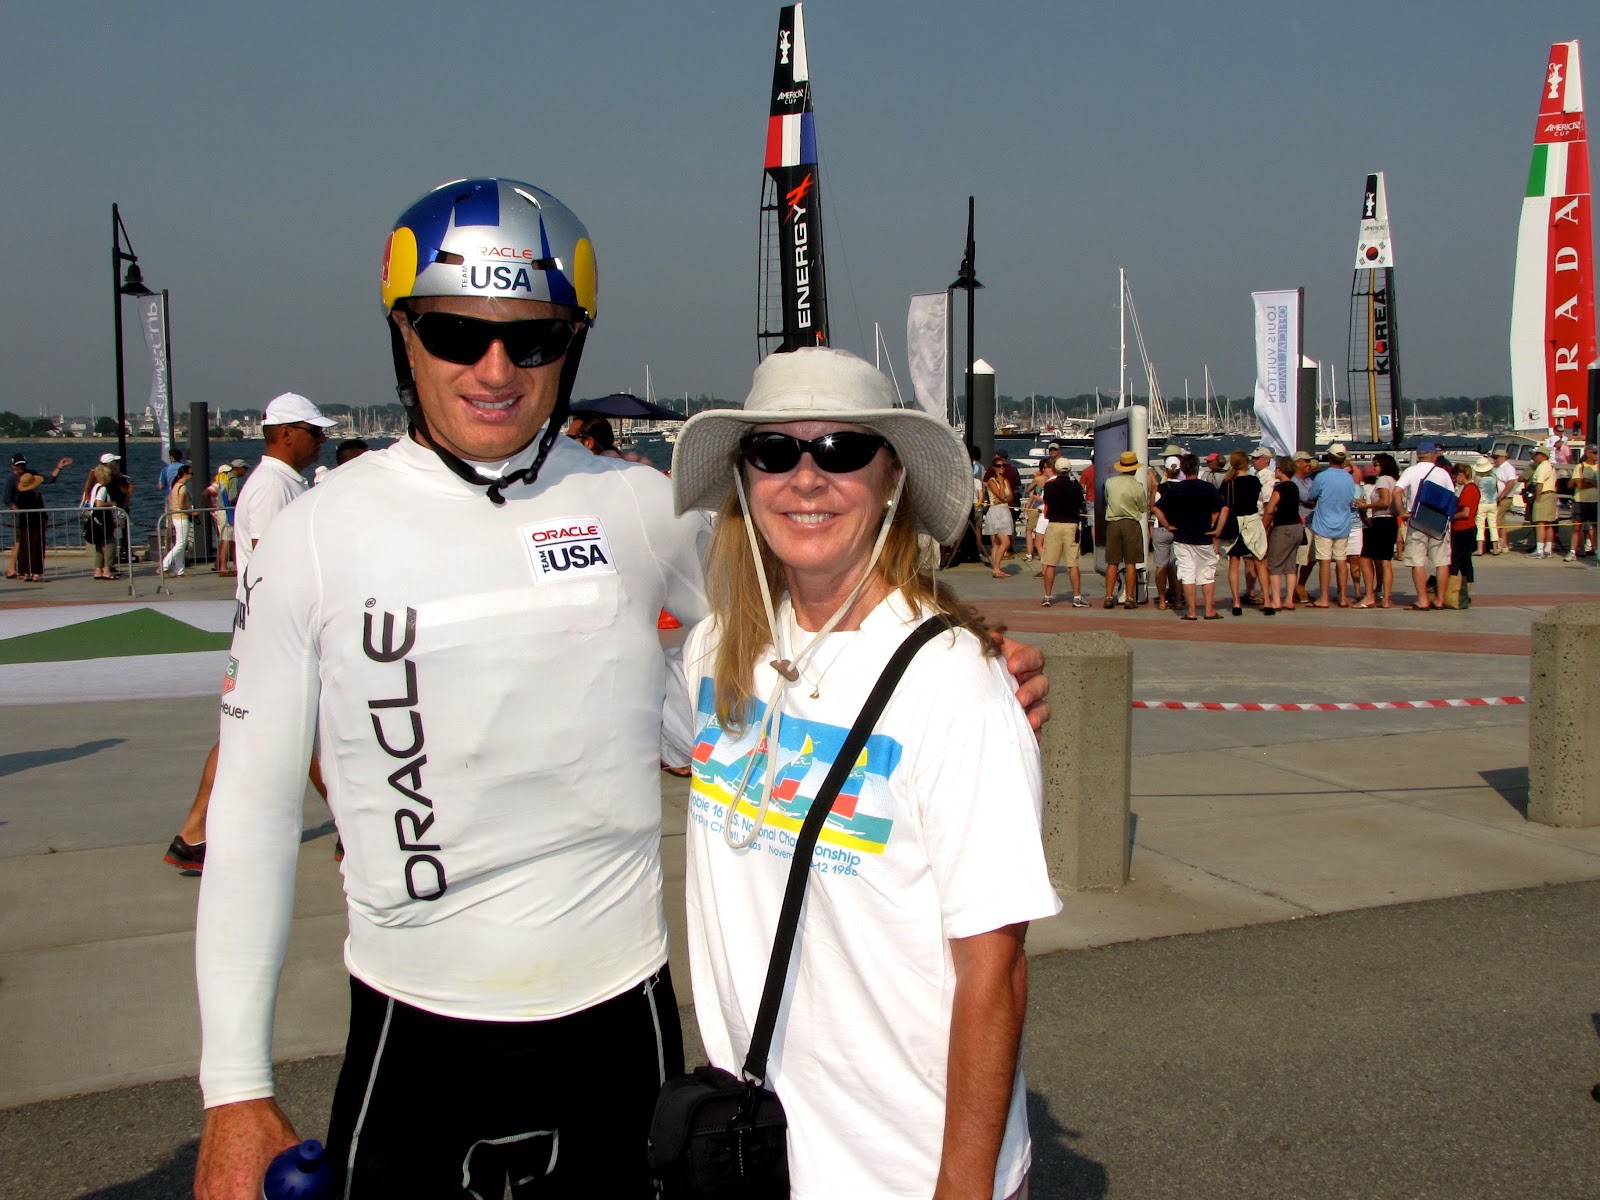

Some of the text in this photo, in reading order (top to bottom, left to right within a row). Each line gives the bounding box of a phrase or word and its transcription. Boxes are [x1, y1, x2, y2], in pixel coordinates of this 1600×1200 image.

[475, 246, 533, 259] RACLE
[793, 203, 811, 328] ENERGY
[471, 265, 532, 292] USA
[1555, 197, 1578, 418] PRADA
[532, 526, 598, 542] ORACLE
[538, 550, 551, 574] TEAM
[547, 544, 608, 571] USA
[690, 793, 710, 812] obie
[713, 803, 723, 818] 16
[742, 817, 776, 841] Naonal
[779, 830, 861, 866] Chaonship
